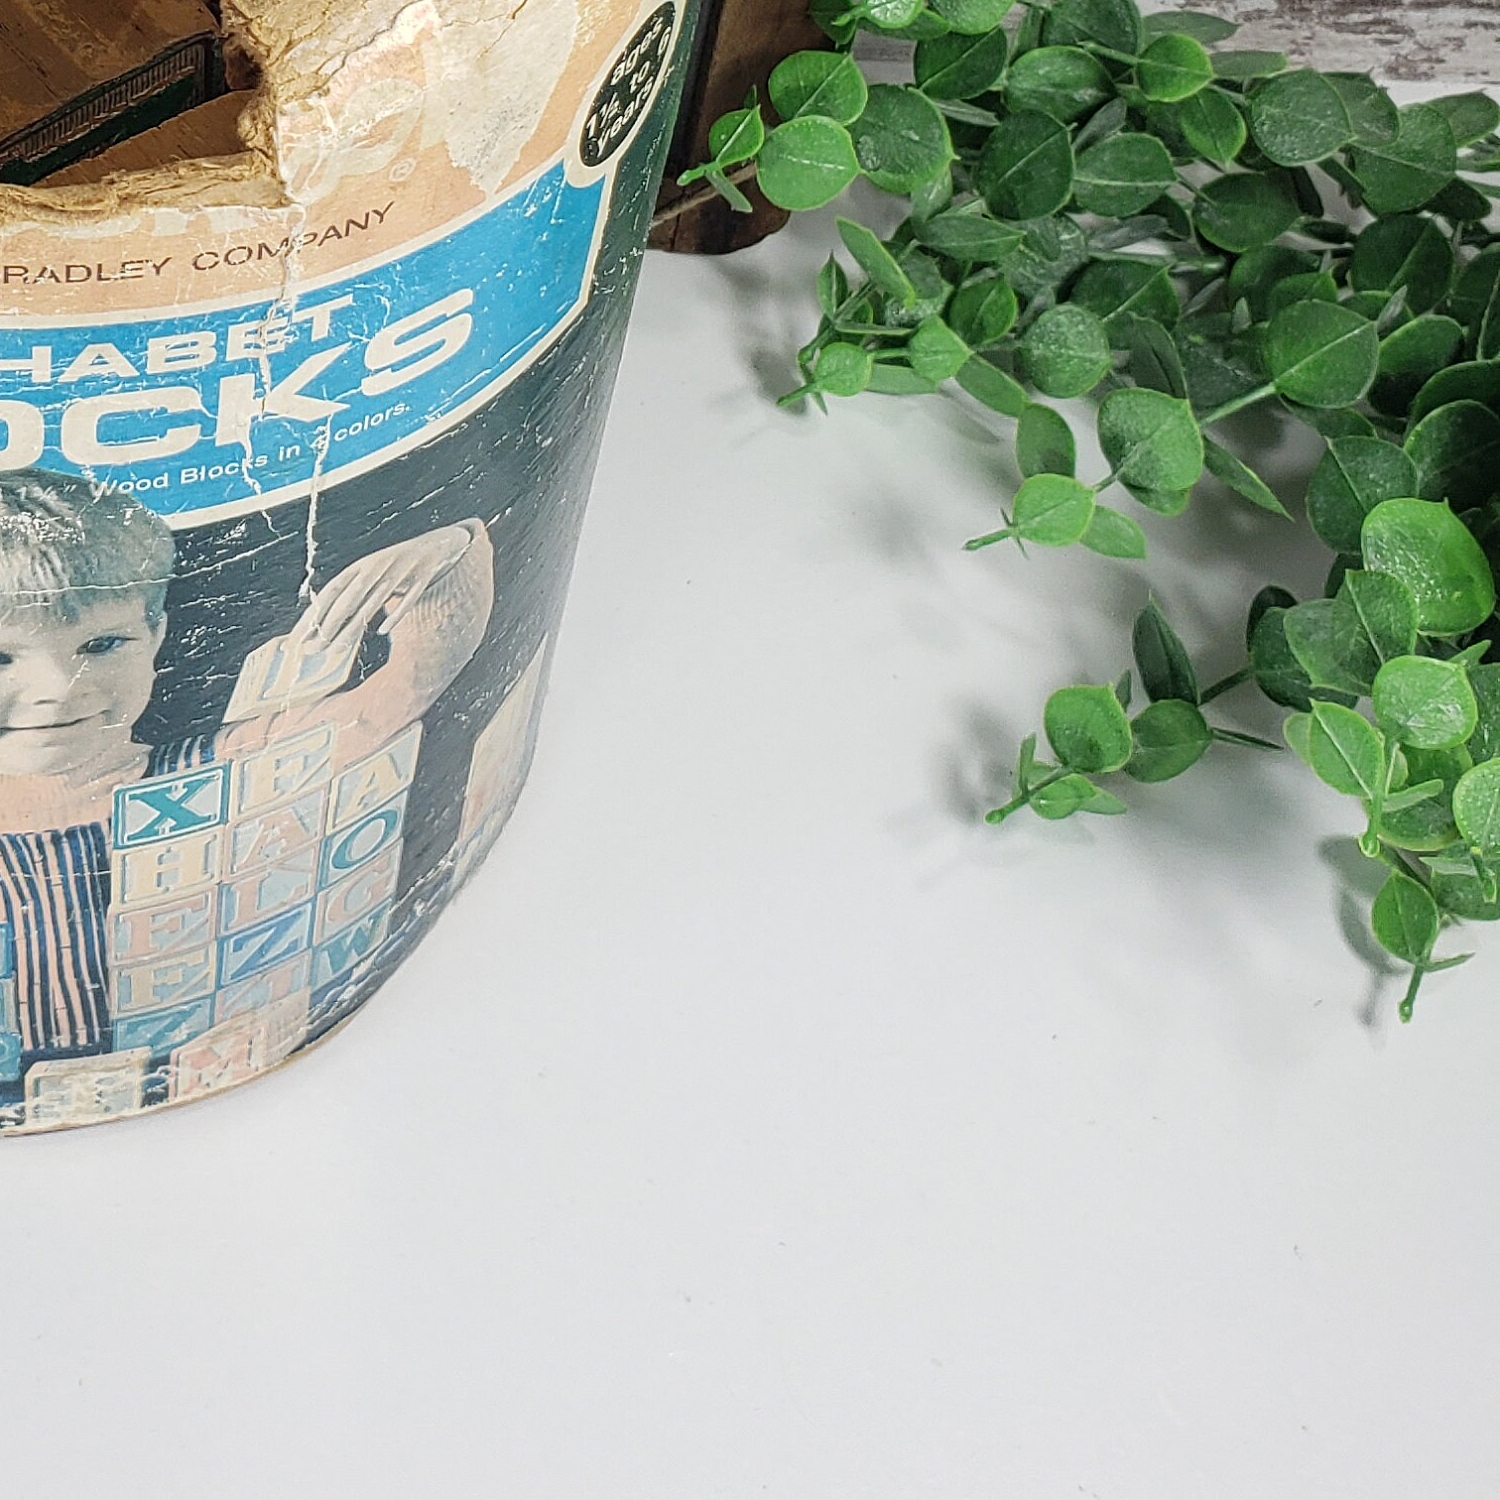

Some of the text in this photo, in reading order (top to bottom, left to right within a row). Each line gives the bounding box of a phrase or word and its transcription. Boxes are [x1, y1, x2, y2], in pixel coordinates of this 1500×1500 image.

[611, 17, 664, 86] ages
[629, 60, 651, 93] to
[597, 76, 654, 158] years
[191, 201, 395, 271] COMPANY
[90, 473, 170, 498] Wood
[181, 453, 268, 485] Blocks
[279, 445, 301, 463] in
[127, 771, 219, 841] X
[331, 809, 401, 870] O
[230, 910, 304, 980] Z
